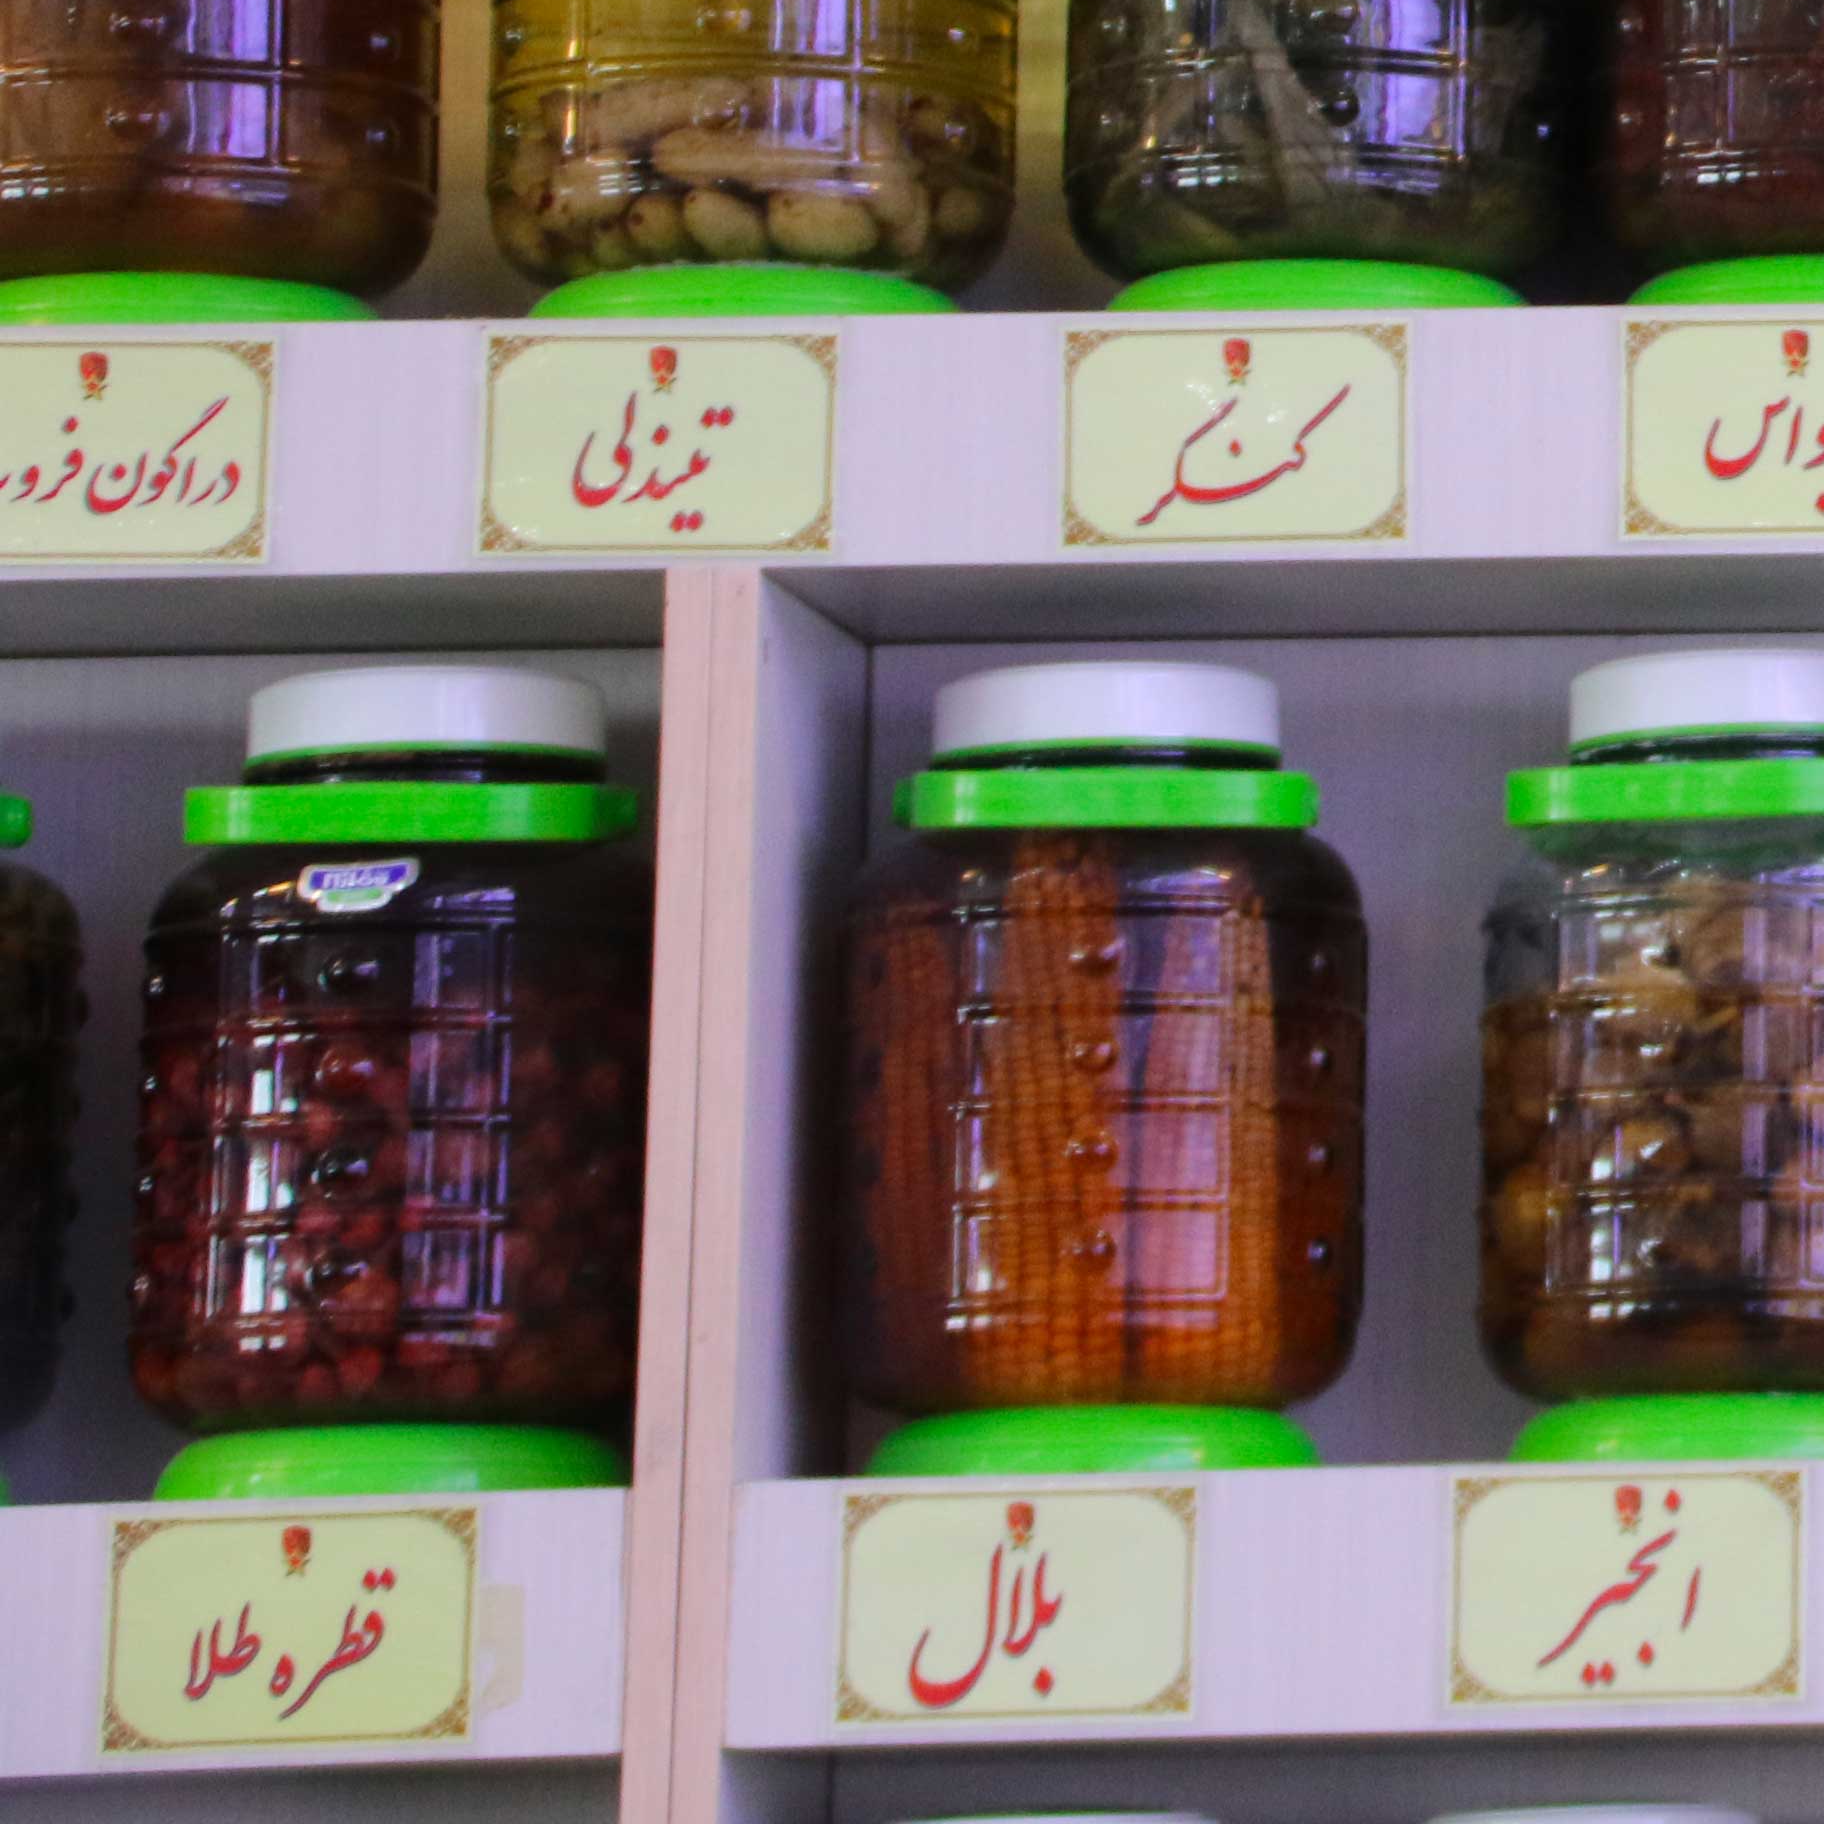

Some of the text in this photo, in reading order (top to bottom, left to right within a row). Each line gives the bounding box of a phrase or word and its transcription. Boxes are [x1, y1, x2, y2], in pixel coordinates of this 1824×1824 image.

[0, 415, 87, 505] فرو
[1134, 381, 1353, 527] کنگر
[185, 1566, 400, 1715] قطره طلا
[906, 1540, 1065, 1711] بلال
[1538, 1488, 1703, 1688] انجیر
